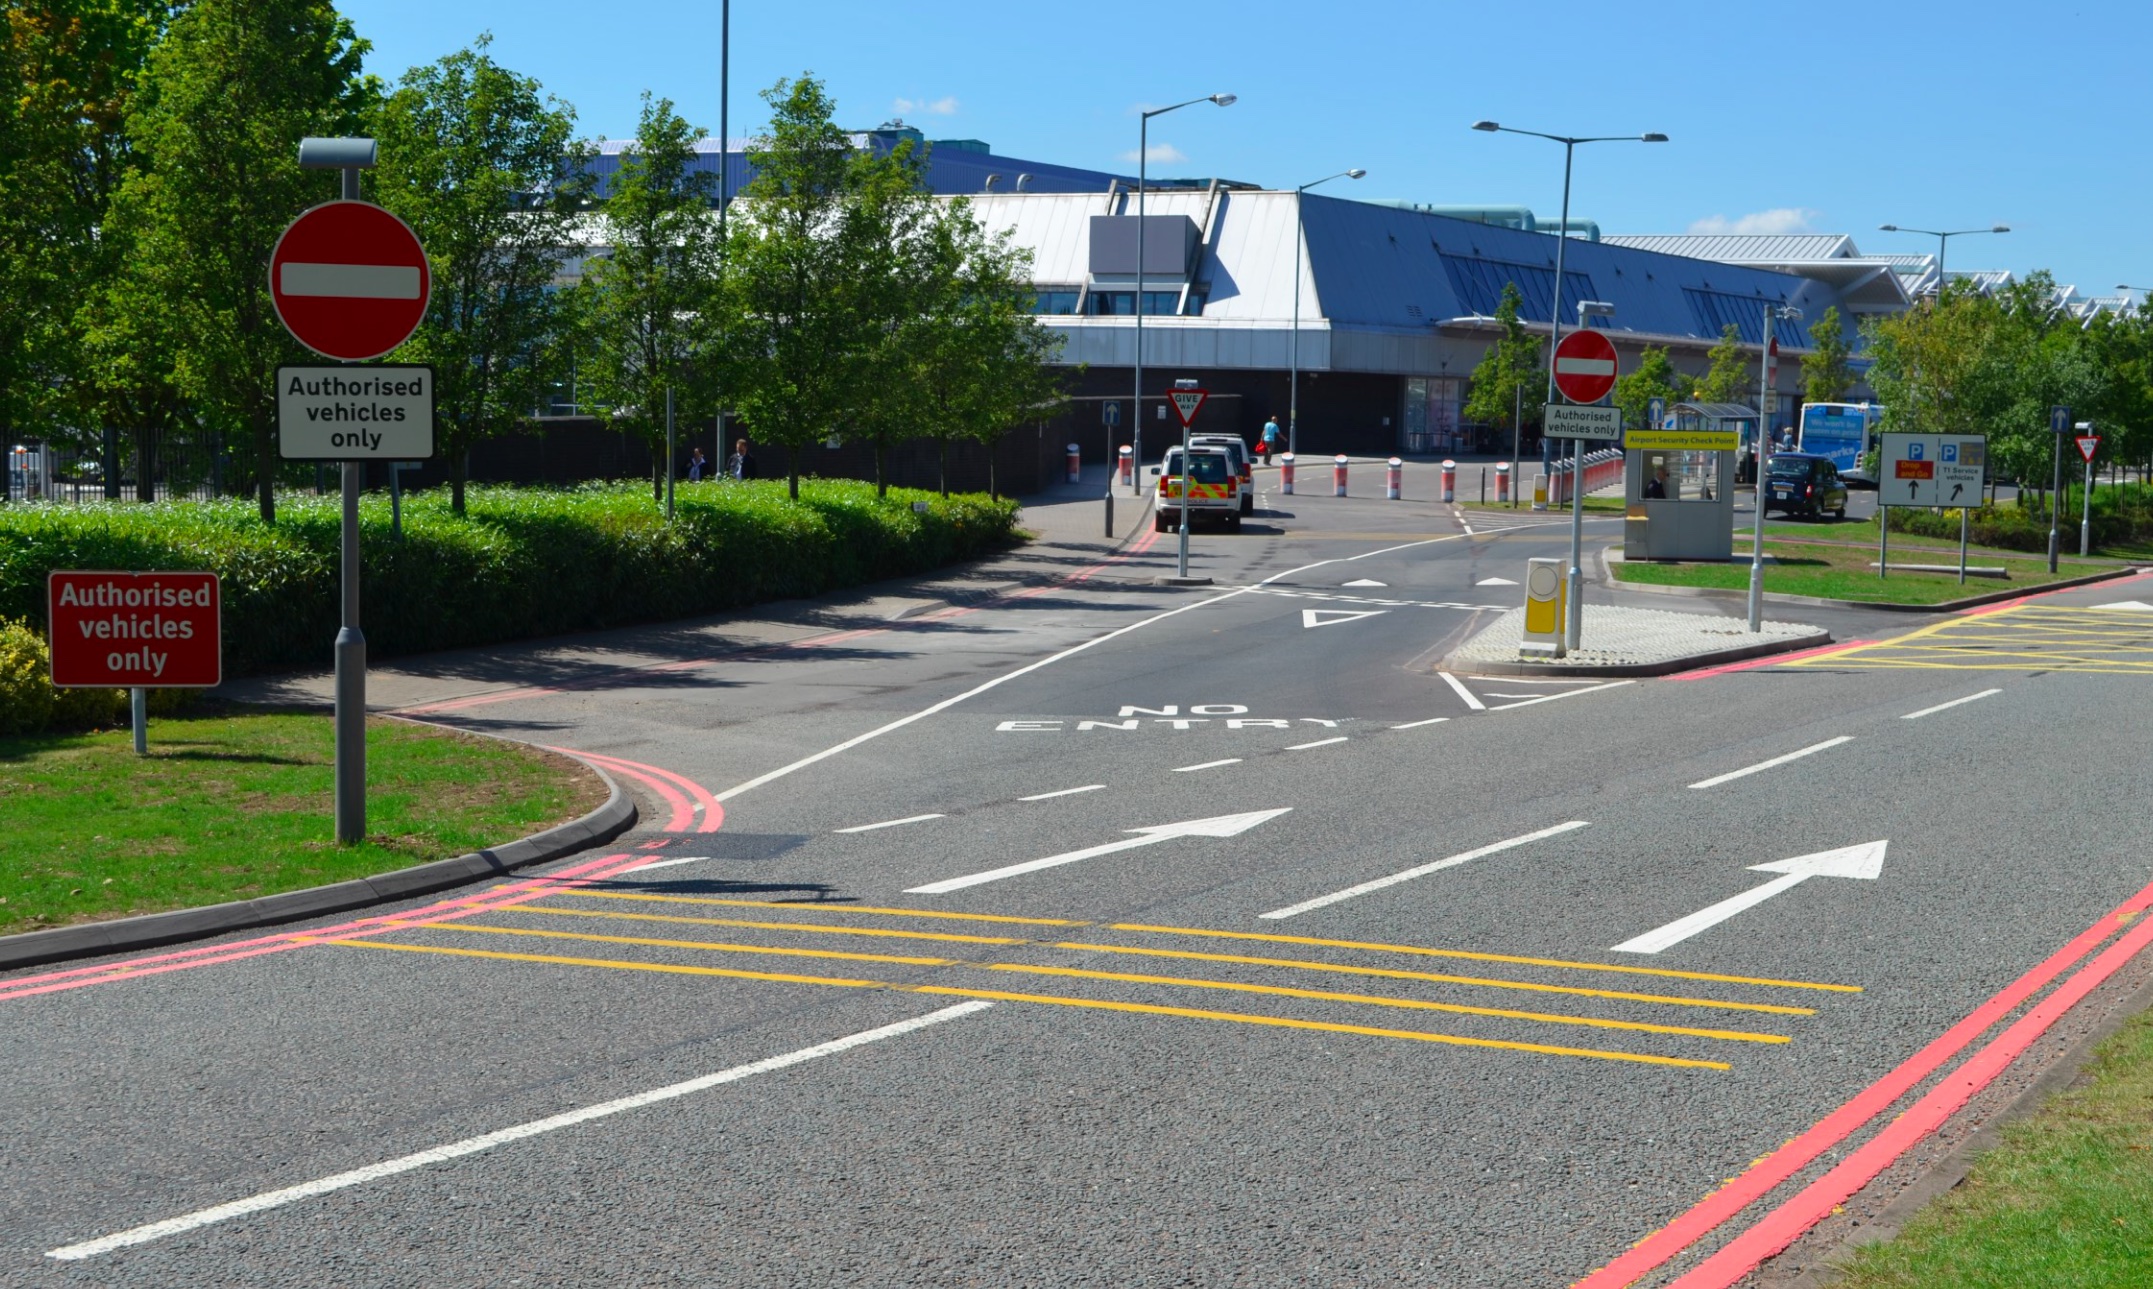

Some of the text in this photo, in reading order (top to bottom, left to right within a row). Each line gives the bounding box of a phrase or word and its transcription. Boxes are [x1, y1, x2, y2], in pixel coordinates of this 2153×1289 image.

[288, 376, 423, 396] Authorised
[1175, 394, 1198, 402] GIVE
[306, 402, 406, 421] vehicles
[1554, 409, 1612, 422] Authorised
[1548, 422, 1616, 437] vehicles only
[331, 428, 382, 450] only
[1630, 436, 1735, 446] Airport Security Check Point
[1910, 445, 1922, 458] P
[1944, 446, 1954, 460] P
[1901, 461, 1920, 470] Drop
[1953, 466, 1978, 474] Service
[1901, 470, 1929, 478] and Go
[59, 582, 211, 607] Authorised
[79, 614, 194, 639] vehicles
[107, 646, 168, 677] only
[1118, 704, 1249, 716] NO
[995, 718, 1360, 731] ENTRY
